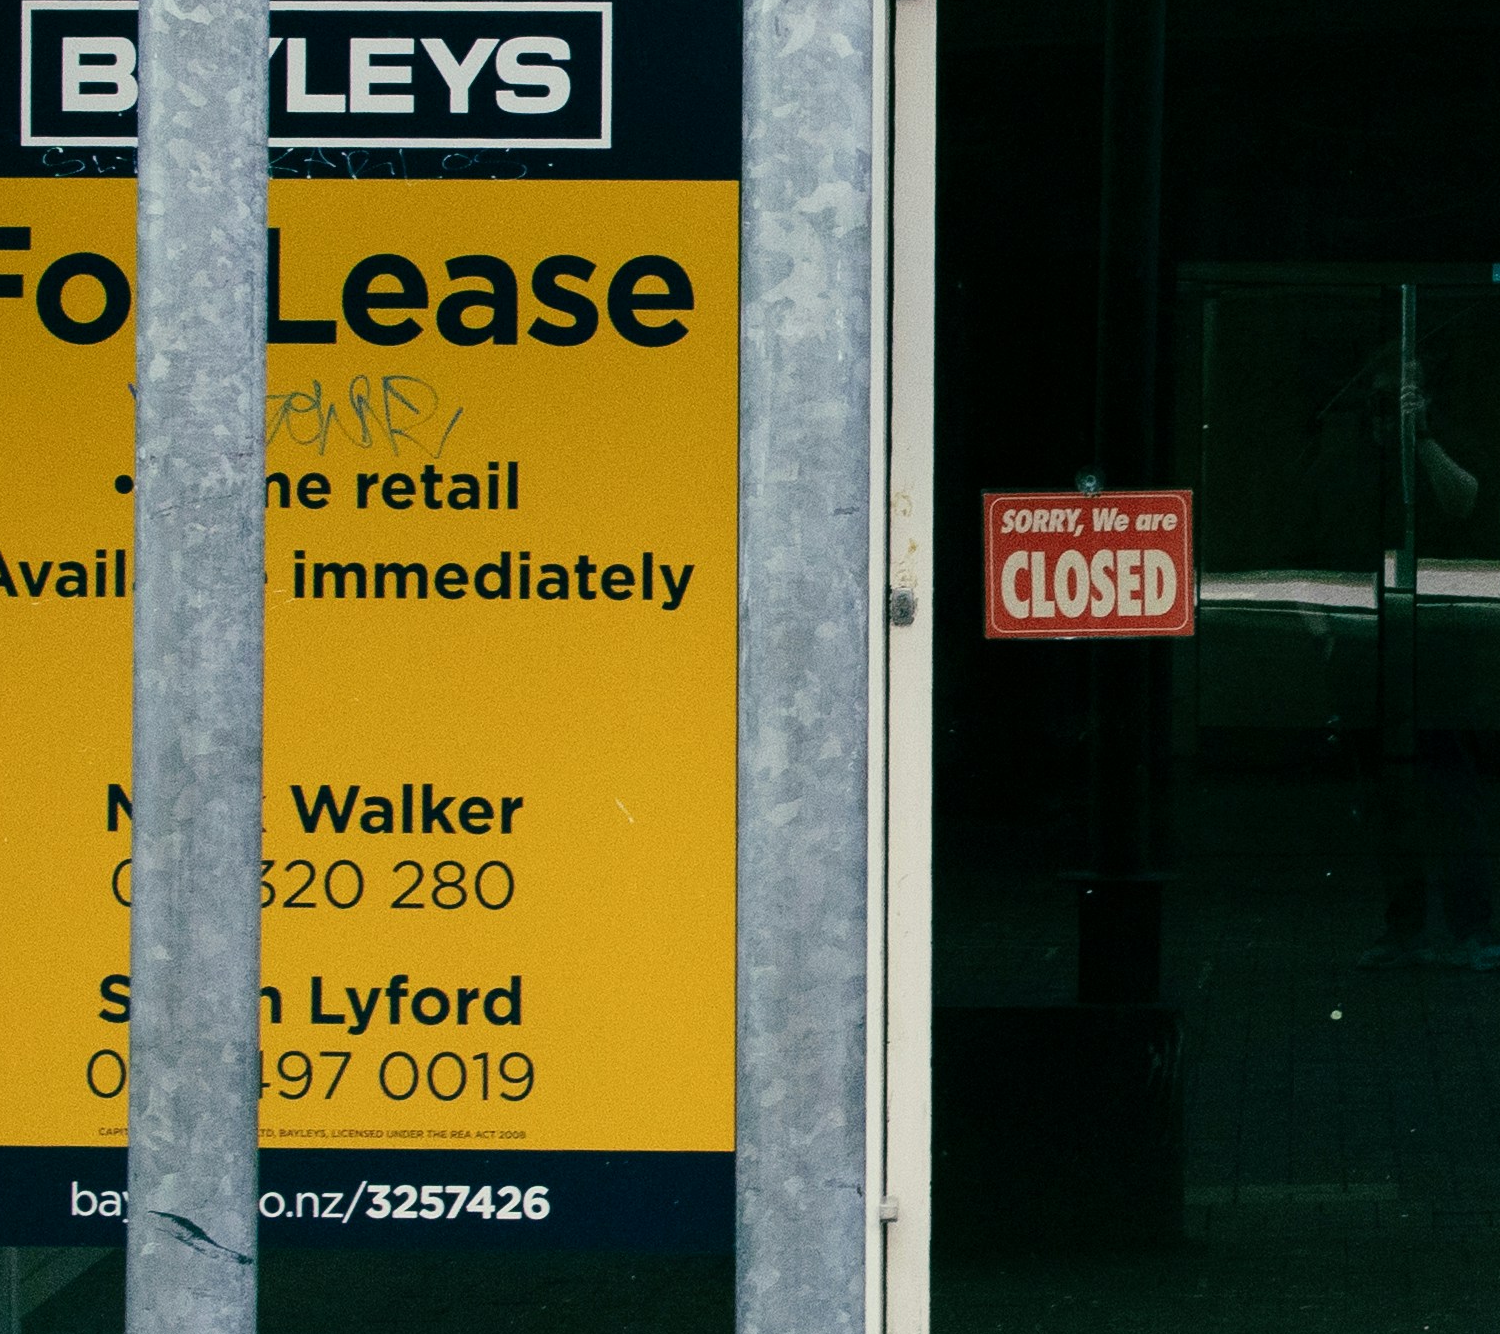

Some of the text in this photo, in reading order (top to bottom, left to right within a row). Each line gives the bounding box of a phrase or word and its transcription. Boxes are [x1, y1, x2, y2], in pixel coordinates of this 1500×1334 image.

[61, 36, 573, 116] BLEYS
[268, 226, 696, 348] Lease
[356, 463, 521, 510] retail
[1001, 507, 1178, 537] SORRY, We are
[293, 552, 697, 612] immediately
[1001, 548, 1178, 619] CLOSED
[290, 783, 525, 836] Walker
[389, 859, 516, 911] 280
[309, 975, 524, 1035] Lyford
[378, 1050, 536, 1102] 0019
[332, 1128, 384, 1139] LICENSED
[386, 1129, 425, 1139] UNDER
[427, 1129, 448, 1139] THE
[474, 1129, 496, 1140] ACT
